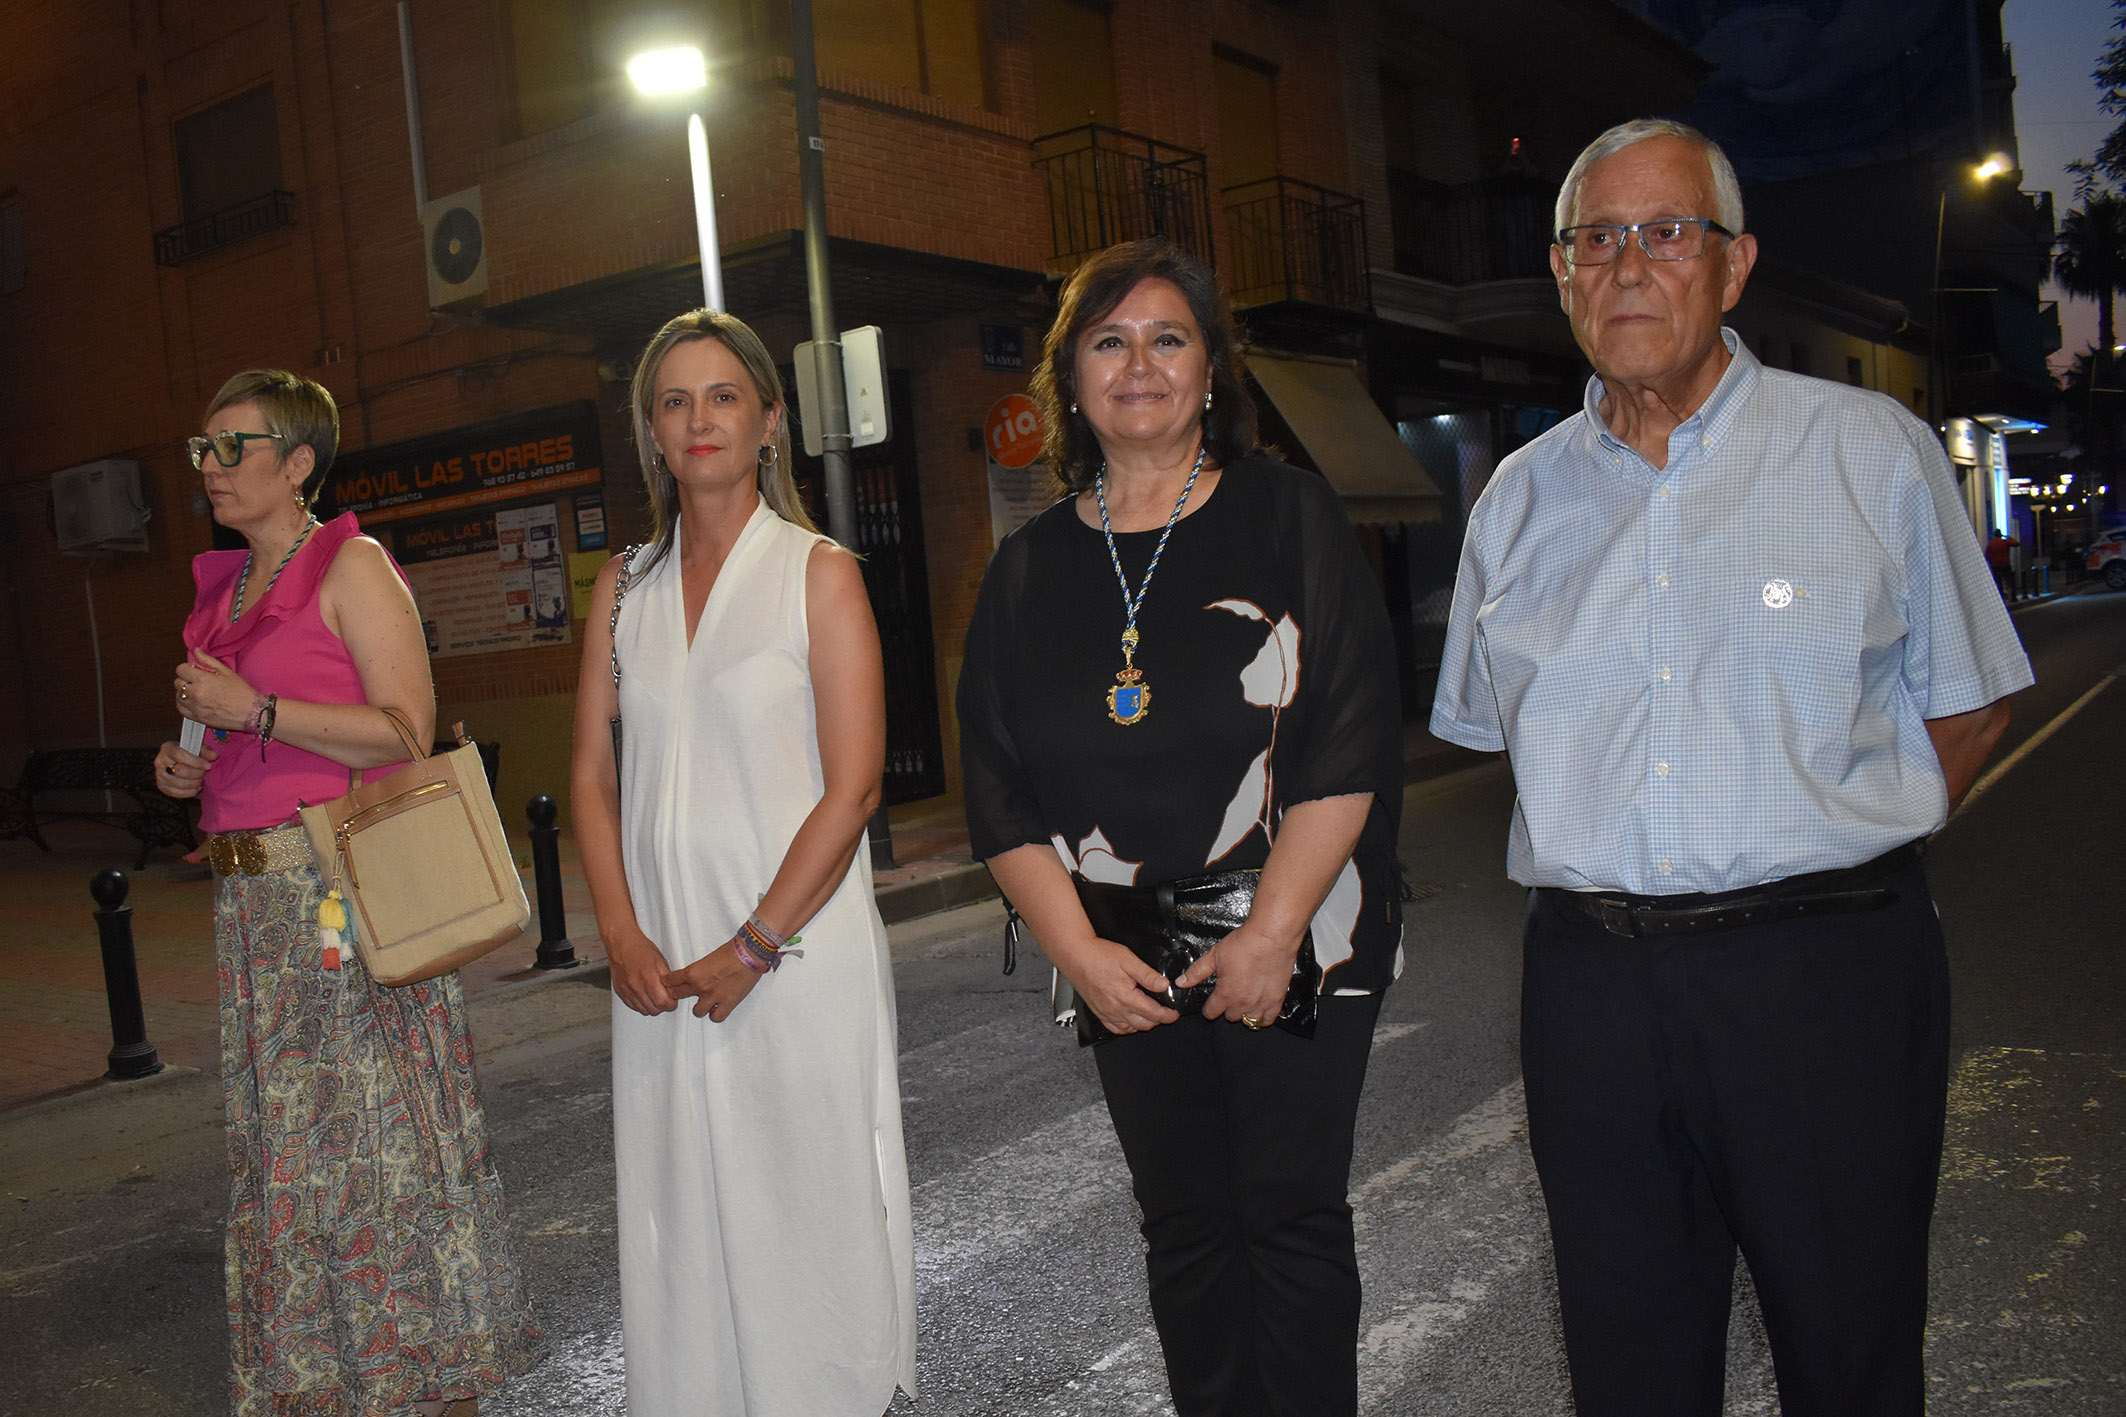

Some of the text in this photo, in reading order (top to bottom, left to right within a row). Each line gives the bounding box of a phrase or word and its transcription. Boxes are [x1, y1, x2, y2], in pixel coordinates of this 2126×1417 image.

[984, 354, 1022, 367] MAYOR
[991, 407, 1038, 450] ria
[335, 434, 575, 504] MÓVIL LAS TORRES
[377, 491, 424, 508] INFORMÁTICA
[405, 527, 451, 548] MÓVIL
[453, 521, 482, 539] LAS
